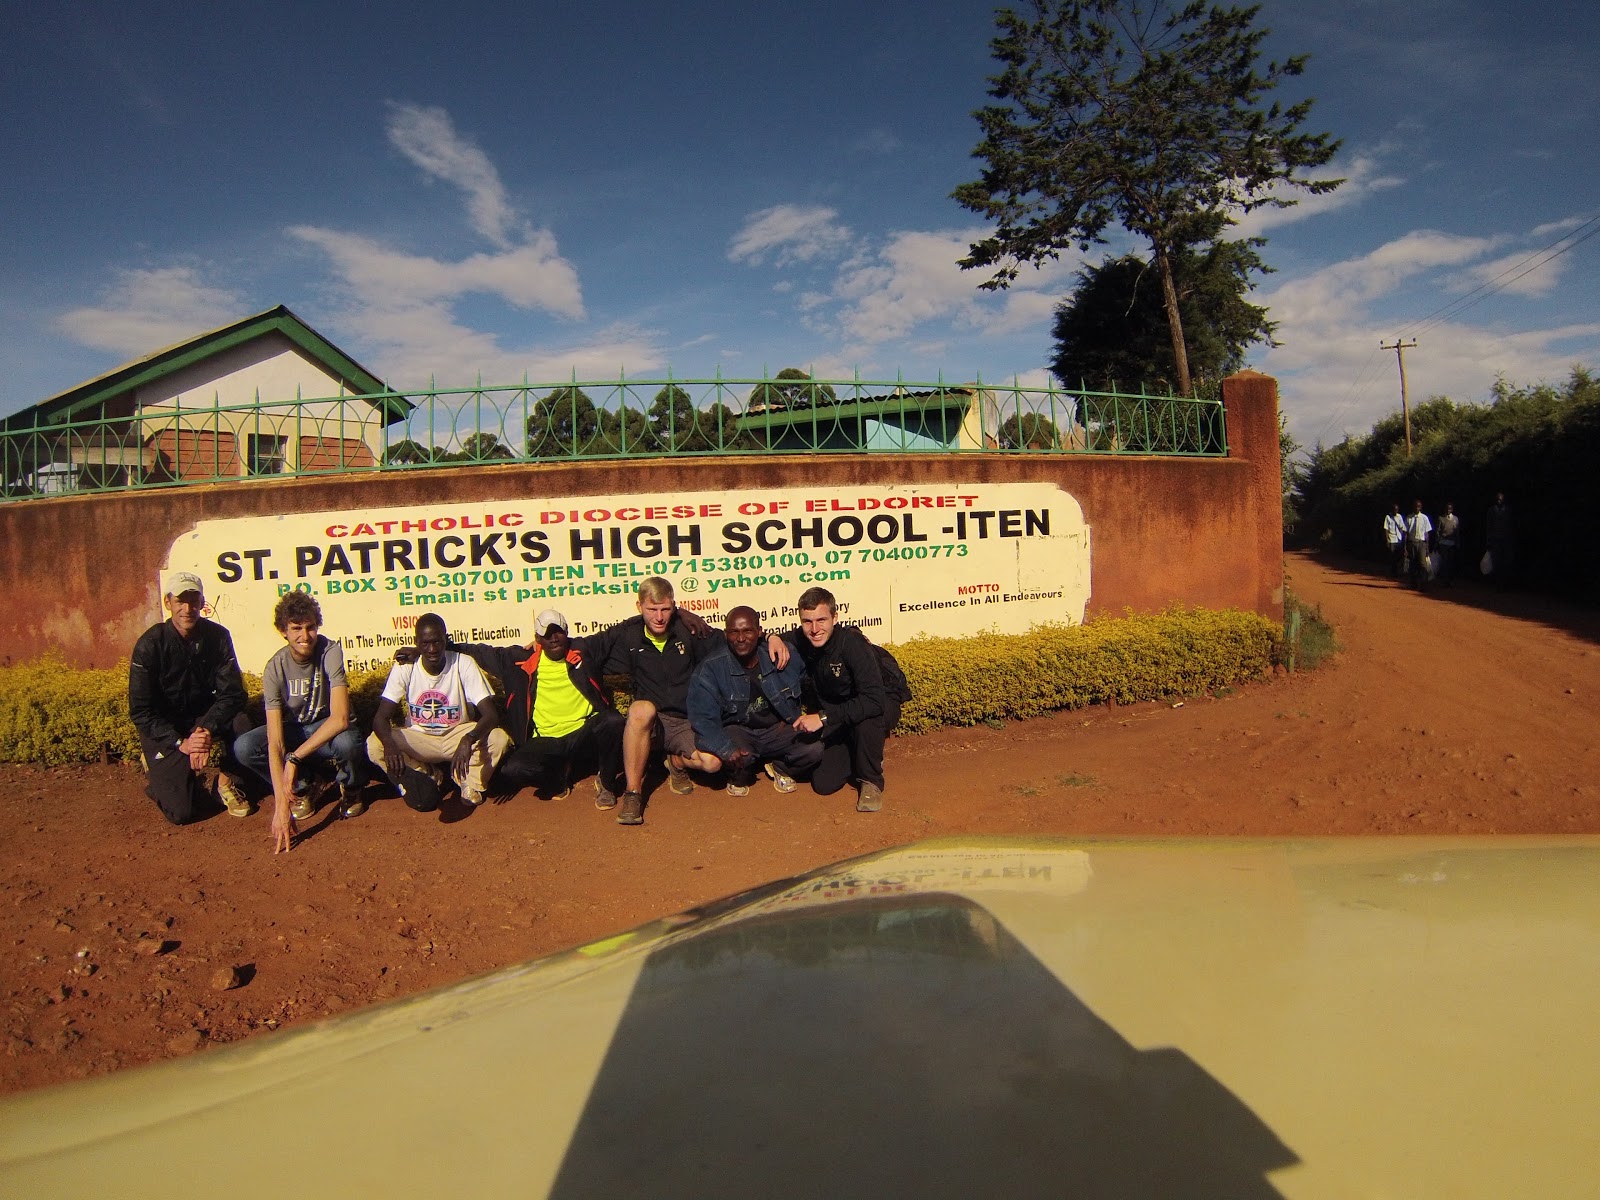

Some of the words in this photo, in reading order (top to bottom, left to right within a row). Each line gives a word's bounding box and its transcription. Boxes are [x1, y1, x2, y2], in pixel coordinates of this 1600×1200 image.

[325, 513, 524, 538] CATHOLIC
[540, 504, 723, 525] DIOCESE
[737, 501, 790, 516] OF
[805, 495, 979, 512] ELDORET
[216, 548, 280, 583] ST.
[295, 530, 551, 578] PATRICK'S
[569, 524, 702, 561] HIGH
[721, 513, 928, 554] SCHOOL
[941, 508, 1050, 540] -ITEN
[327, 577, 377, 595] BOX
[384, 568, 514, 591] 310-30700
[522, 564, 584, 582] ITEN
[399, 588, 475, 606] Email:
[483, 589, 508, 602] st
[707, 574, 790, 594] yahoo.
[798, 568, 851, 583] com
[957, 583, 1000, 595] MOTTO
[679, 598, 719, 611] MISSION
[771, 607, 779, 617] A
[899, 599, 967, 613] Excellence
[970, 596, 981, 606] In
[984, 594, 1000, 605] All
[1003, 590, 1063, 603] Endeavours
[392, 615, 421, 629] VISIO
[574, 622, 588, 634] To
[344, 636, 355, 648] In
[356, 634, 374, 648] The
[471, 626, 521, 641] Education
